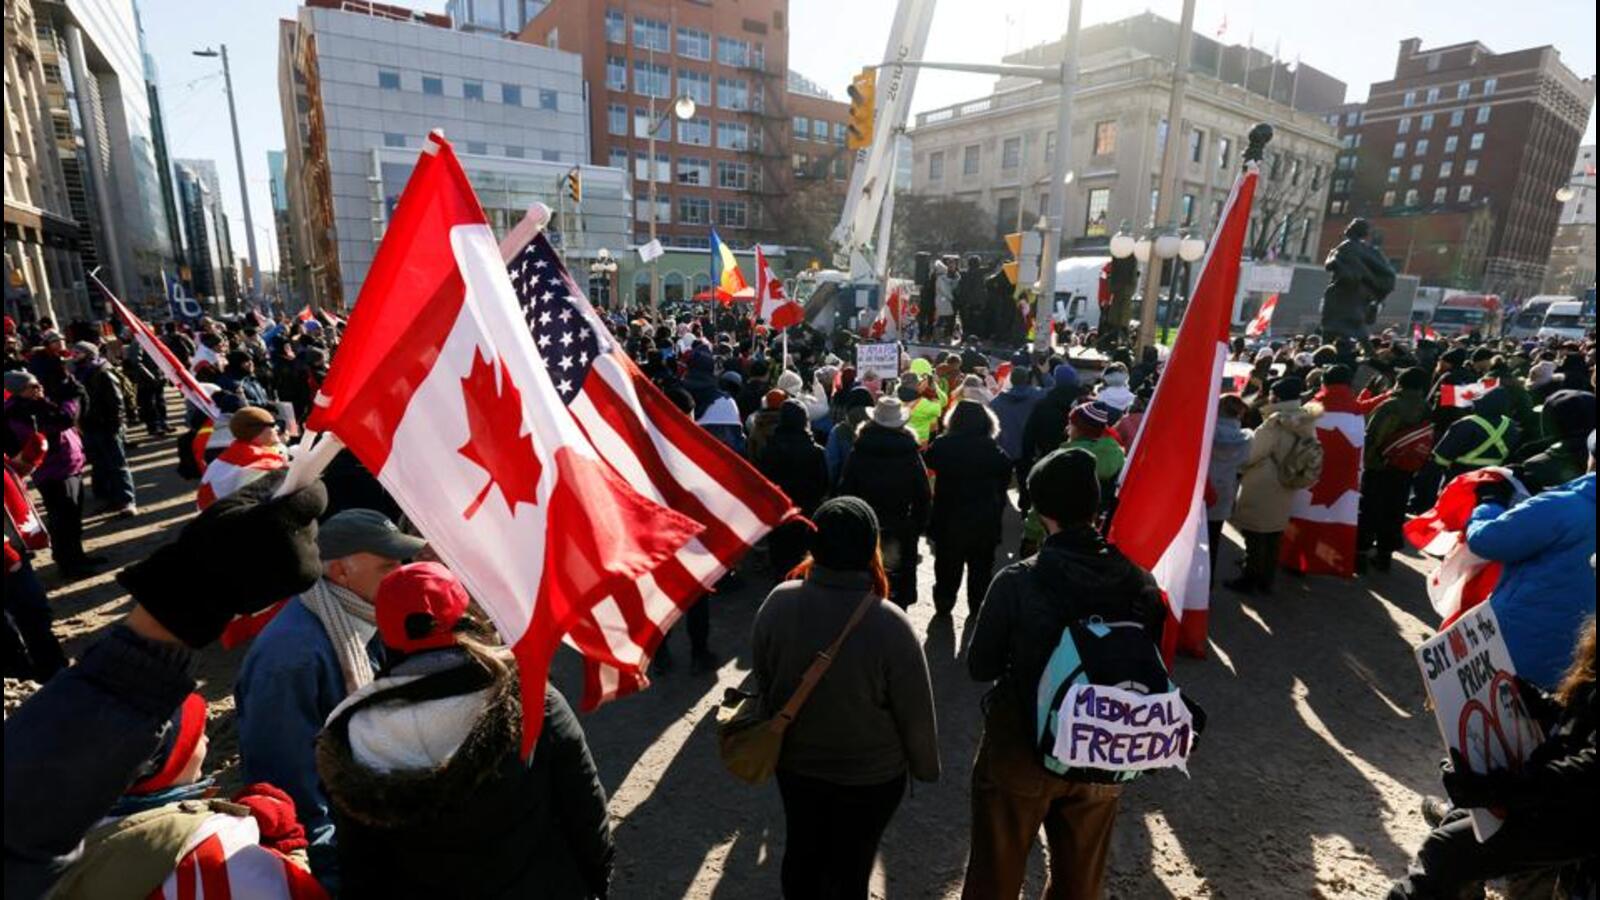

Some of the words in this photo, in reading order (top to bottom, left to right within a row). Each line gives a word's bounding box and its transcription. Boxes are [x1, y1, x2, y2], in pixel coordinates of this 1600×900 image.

[1422, 641, 1451, 680] SAY
[1475, 612, 1496, 643] the
[1457, 649, 1497, 699] PRICK
[1074, 687, 1182, 727] MEDICAL
[1070, 723, 1190, 765] FREEDOM
